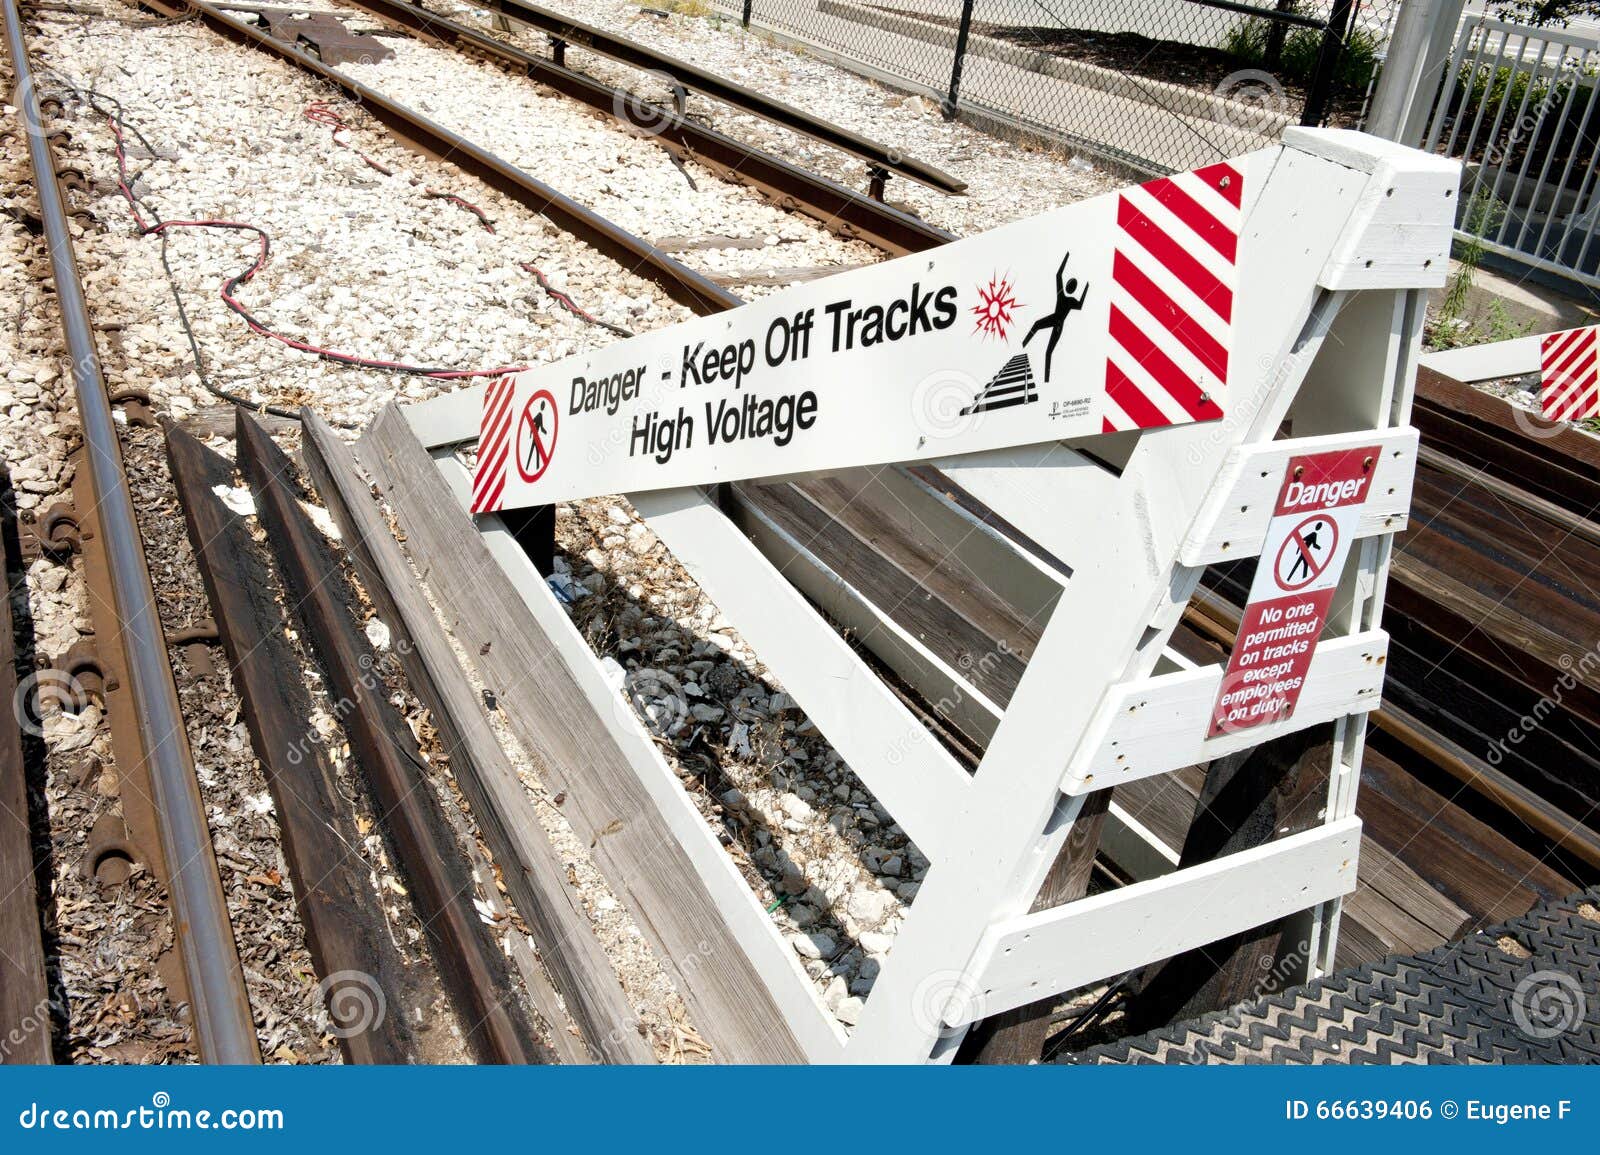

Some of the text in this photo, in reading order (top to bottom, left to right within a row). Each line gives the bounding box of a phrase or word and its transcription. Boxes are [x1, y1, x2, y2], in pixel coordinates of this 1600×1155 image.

[569, 282, 958, 416] Danger - Keep Off Tracks
[629, 391, 818, 465] High Voltage
[1283, 477, 1366, 508] Danger
[1259, 602, 1315, 625] No one
[1243, 616, 1319, 651] permitted
[1239, 638, 1309, 667] on tracks
[1242, 658, 1295, 683] except
[1220, 676, 1302, 706] employees
[1228, 697, 1284, 722] on duty
